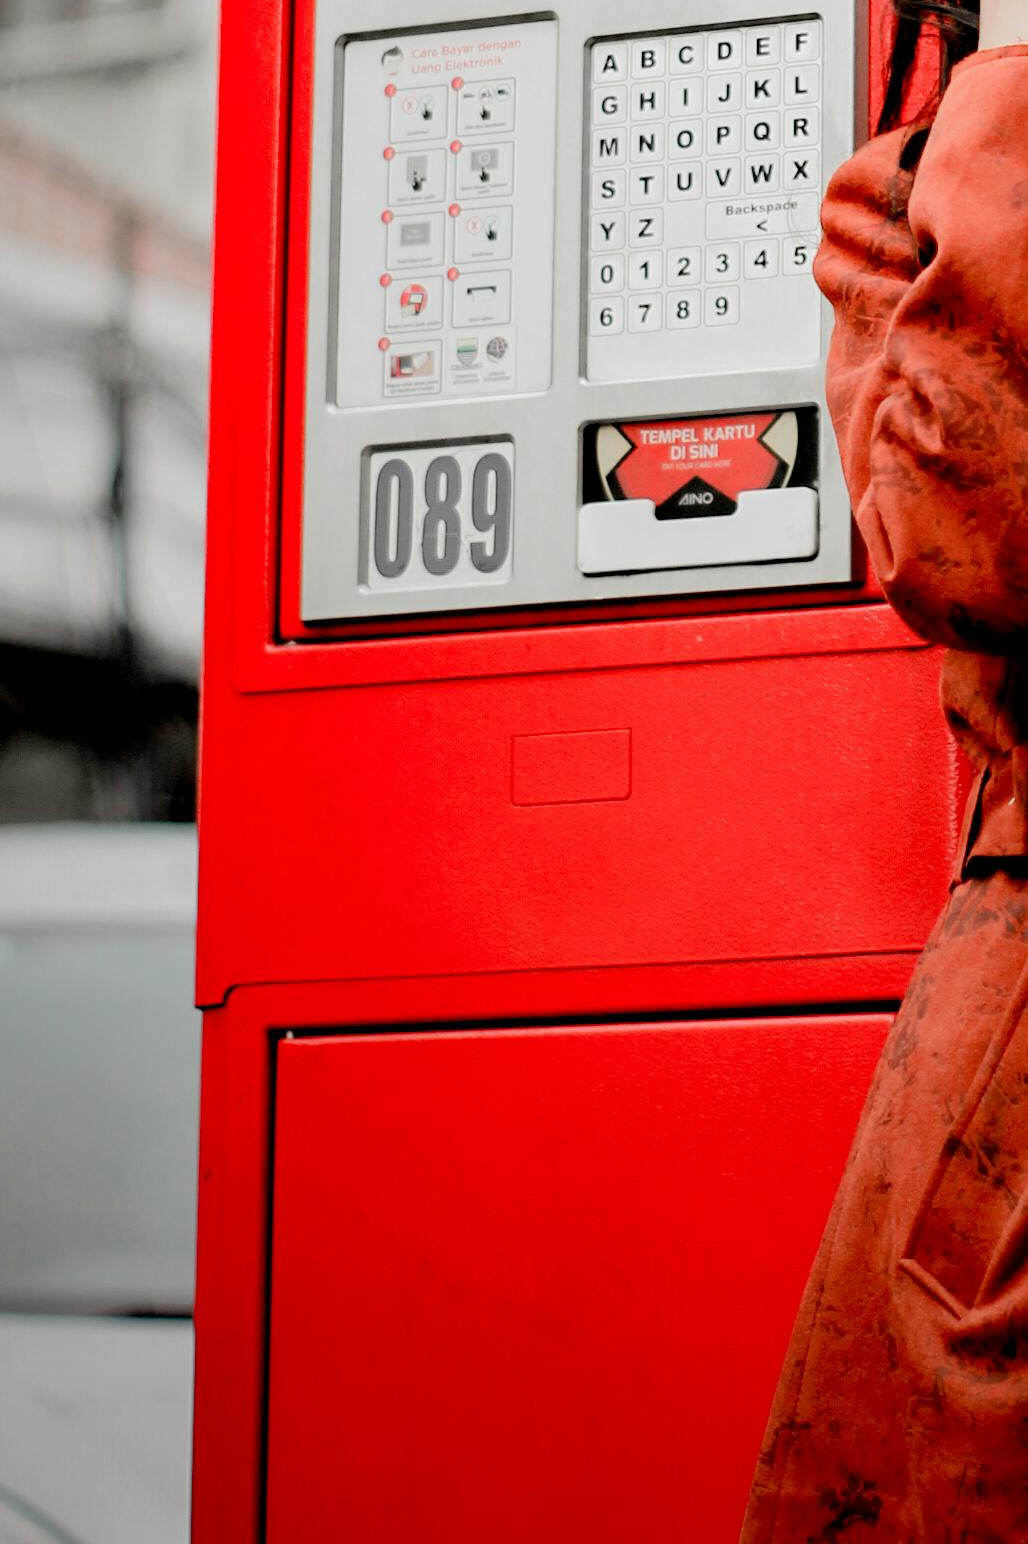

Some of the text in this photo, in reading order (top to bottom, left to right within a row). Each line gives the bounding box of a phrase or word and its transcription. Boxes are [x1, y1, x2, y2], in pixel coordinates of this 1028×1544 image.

[412, 39, 522, 59] Cara Bayar dengan
[603, 33, 808, 72] A B C D E F
[412, 56, 503, 74] Uang Elektronik
[601, 76, 807, 114] G H I J K L
[600, 118, 808, 156] M N O P Q R
[601, 161, 808, 198] S T U V W X
[725, 198, 798, 217] Backspace
[600, 219, 653, 240] Y Z
[601, 246, 806, 283] 0 1 2 3 4 5
[600, 297, 728, 326] 6 7 8 9
[640, 424, 755, 444] TEMPEL KARTU
[671, 444, 719, 460] DI SINI
[678, 492, 714, 506] AINO
[374, 452, 512, 579] 089
